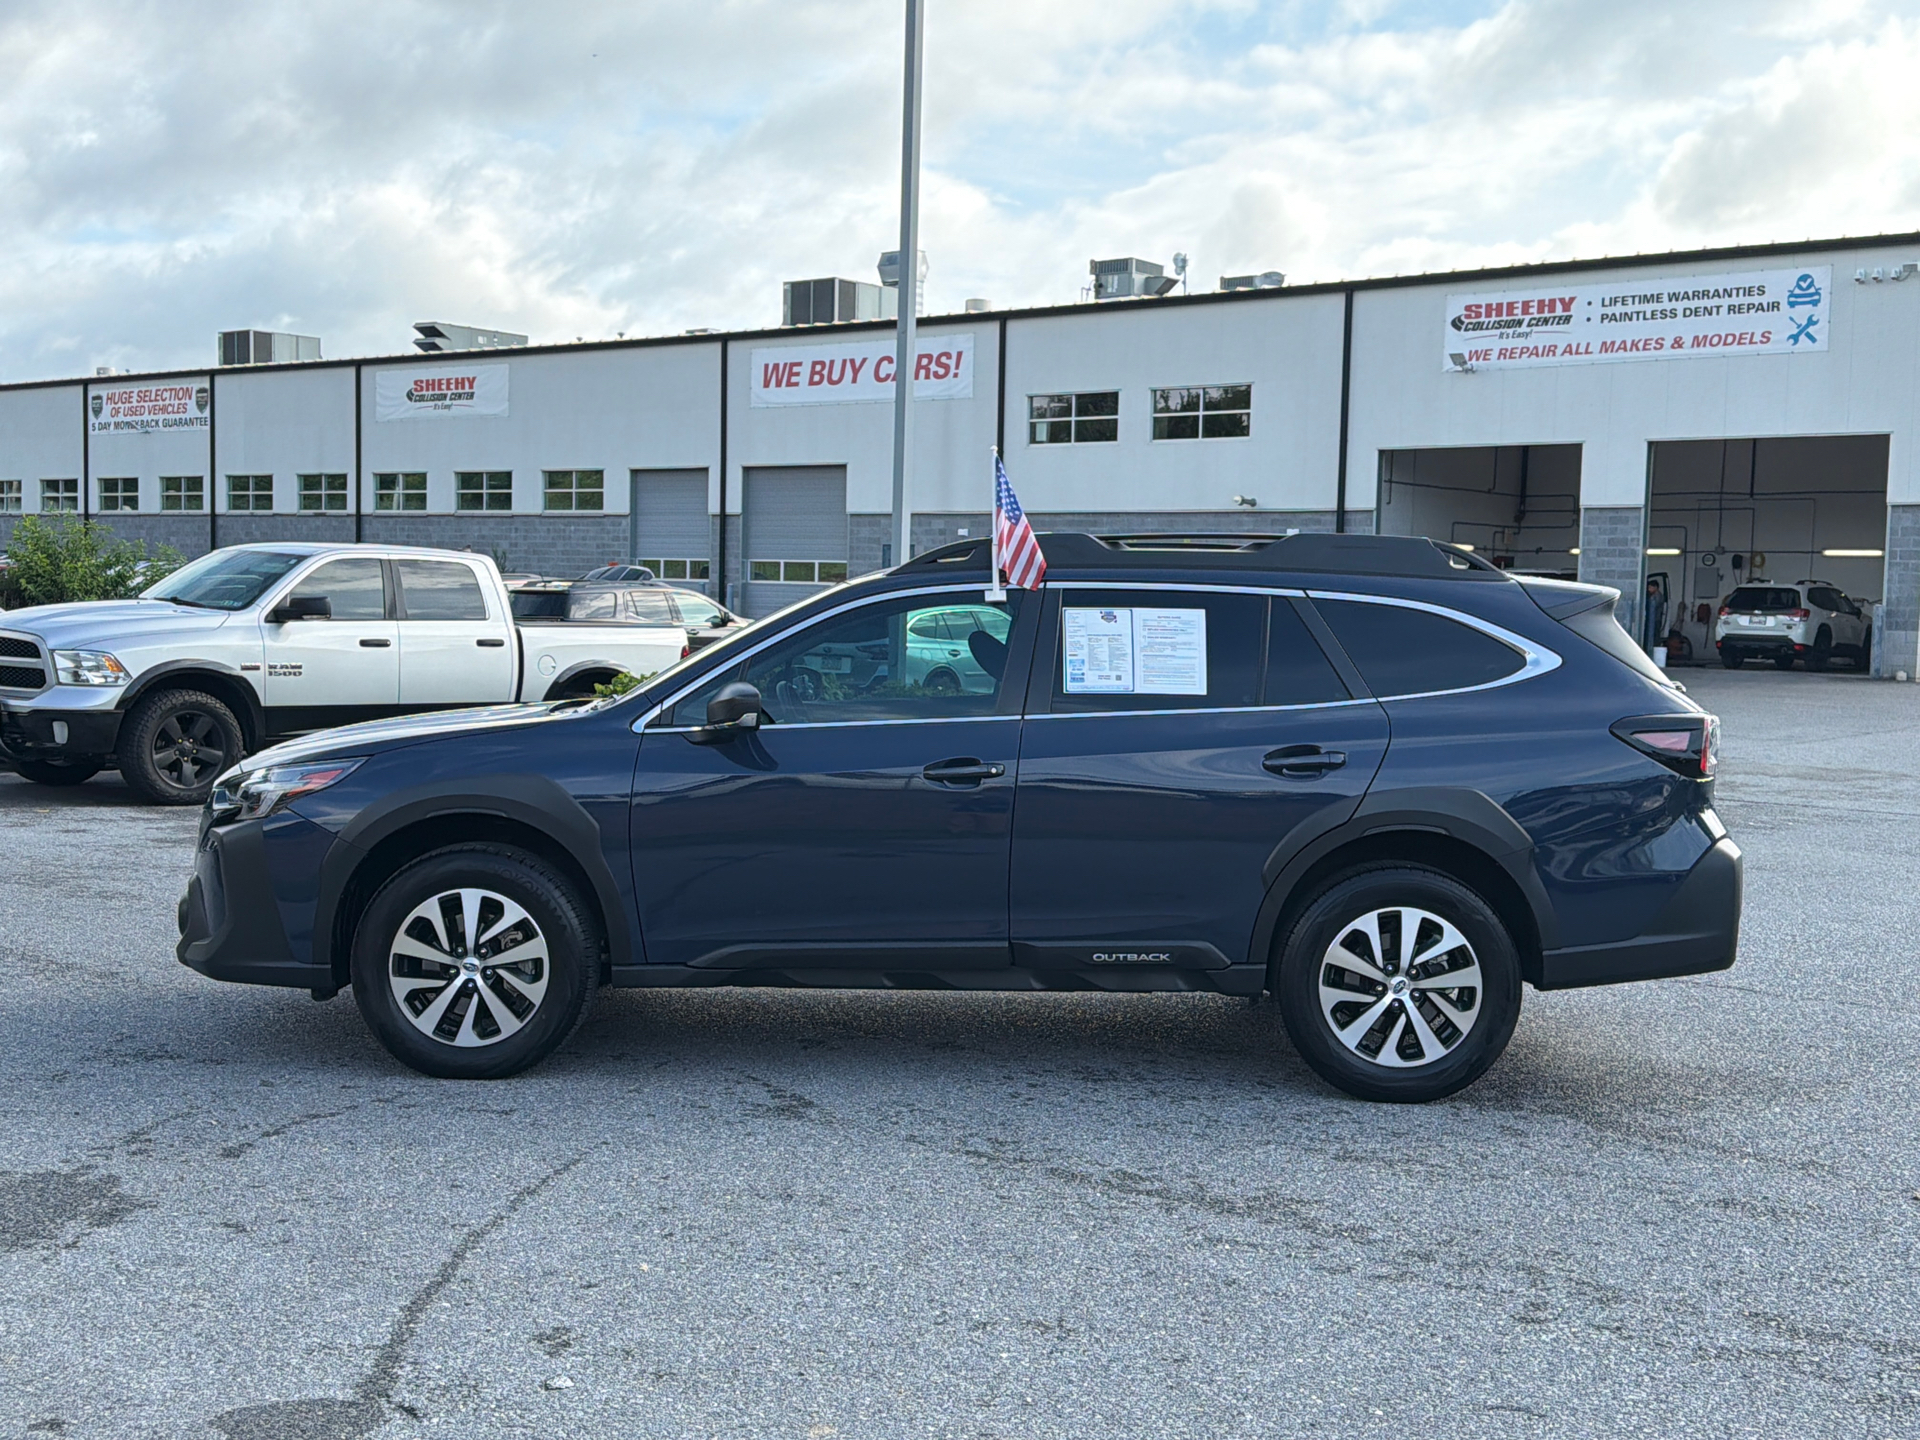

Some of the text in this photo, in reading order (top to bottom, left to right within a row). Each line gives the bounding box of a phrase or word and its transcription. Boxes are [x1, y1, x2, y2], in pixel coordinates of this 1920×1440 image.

[1601, 285, 1766, 308] LIFETIME WARRANTIES
[1463, 296, 1578, 320] SHEEHY
[1600, 301, 1781, 324] PAINTLESS DENT REPAIR
[1463, 314, 1573, 333] COLLISION CENTER
[1498, 329, 1533, 340] It's Easy!
[1467, 330, 1773, 362] WE REPAIR ALL MAKES & MODELS
[762, 350, 964, 389] WE BUY CRS!
[413, 376, 478, 393] SHEEHY
[105, 390, 135, 406] HUGE
[136, 386, 194, 404] SELECTION
[413, 391, 476, 403] COLLISION CENTER
[110, 402, 188, 418] OF USED VEHICLES
[91, 422, 97, 432] 5
[97, 421, 112, 431] DAY
[162, 416, 209, 428] GUARANTEE
[1092, 952, 1171, 962] OUTBACK
